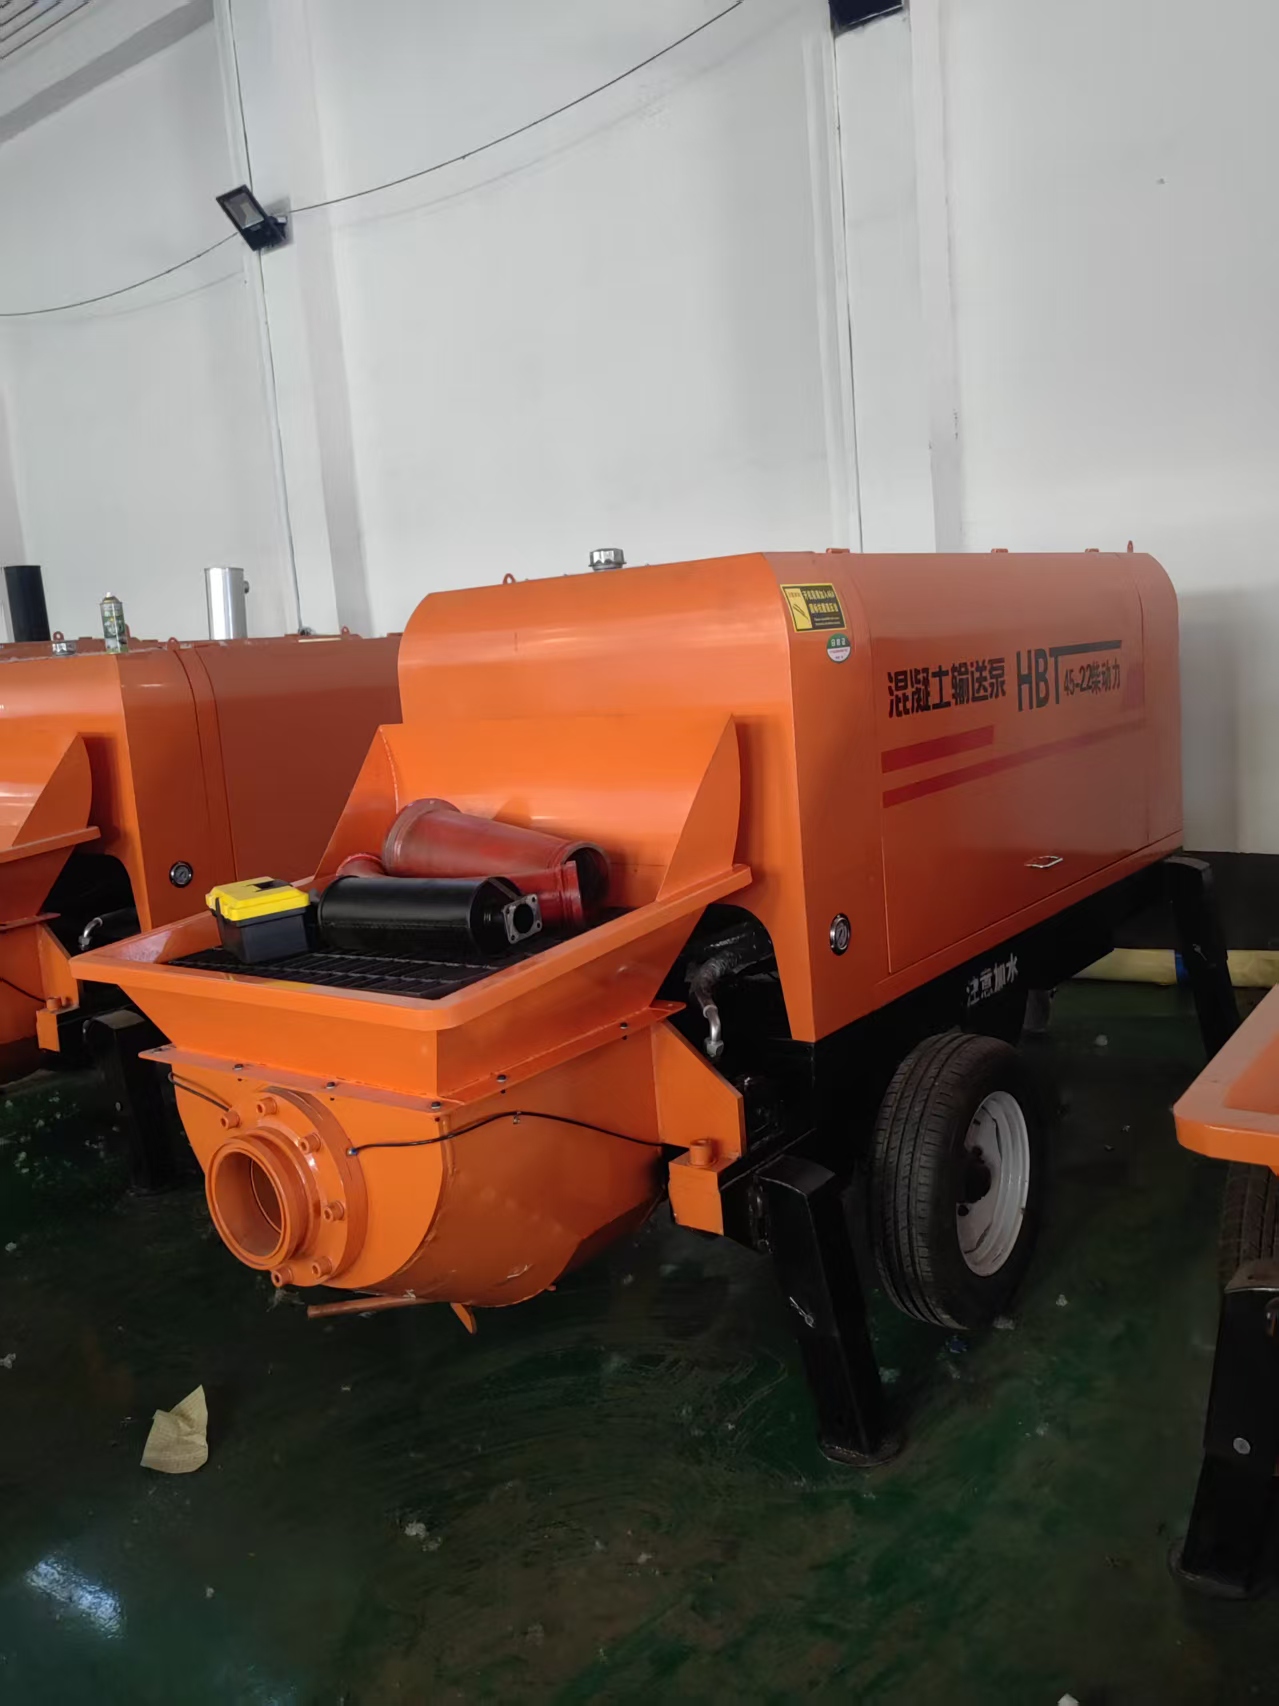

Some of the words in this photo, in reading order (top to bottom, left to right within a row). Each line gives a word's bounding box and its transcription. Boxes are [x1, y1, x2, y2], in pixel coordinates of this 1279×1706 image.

[887, 657, 1007, 718] 混凝土输送泵
[966, 952, 1019, 1007] 注意加水
